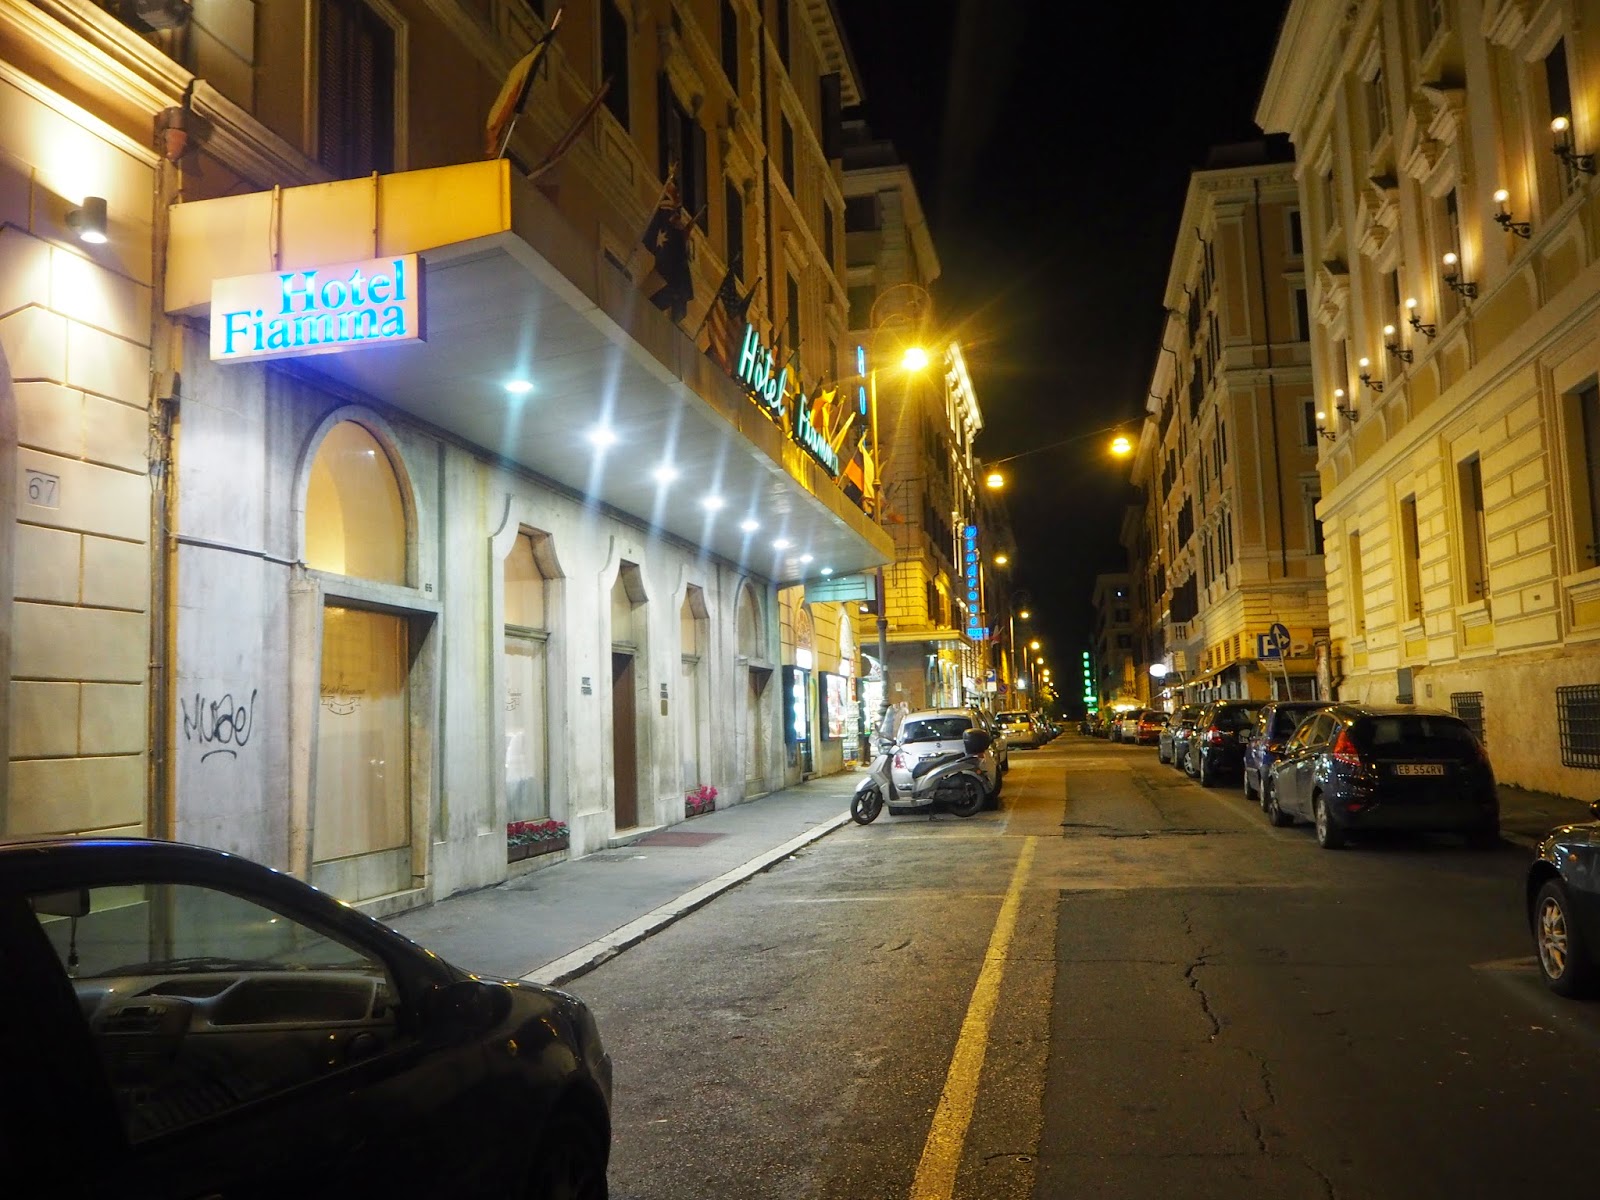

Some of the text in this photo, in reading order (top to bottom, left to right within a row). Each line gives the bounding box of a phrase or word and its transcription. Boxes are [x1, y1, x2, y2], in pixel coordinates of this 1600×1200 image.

[278, 259, 407, 315] Hotel
[222, 305, 407, 354] Fiamma
[29, 477, 56, 503] 67
